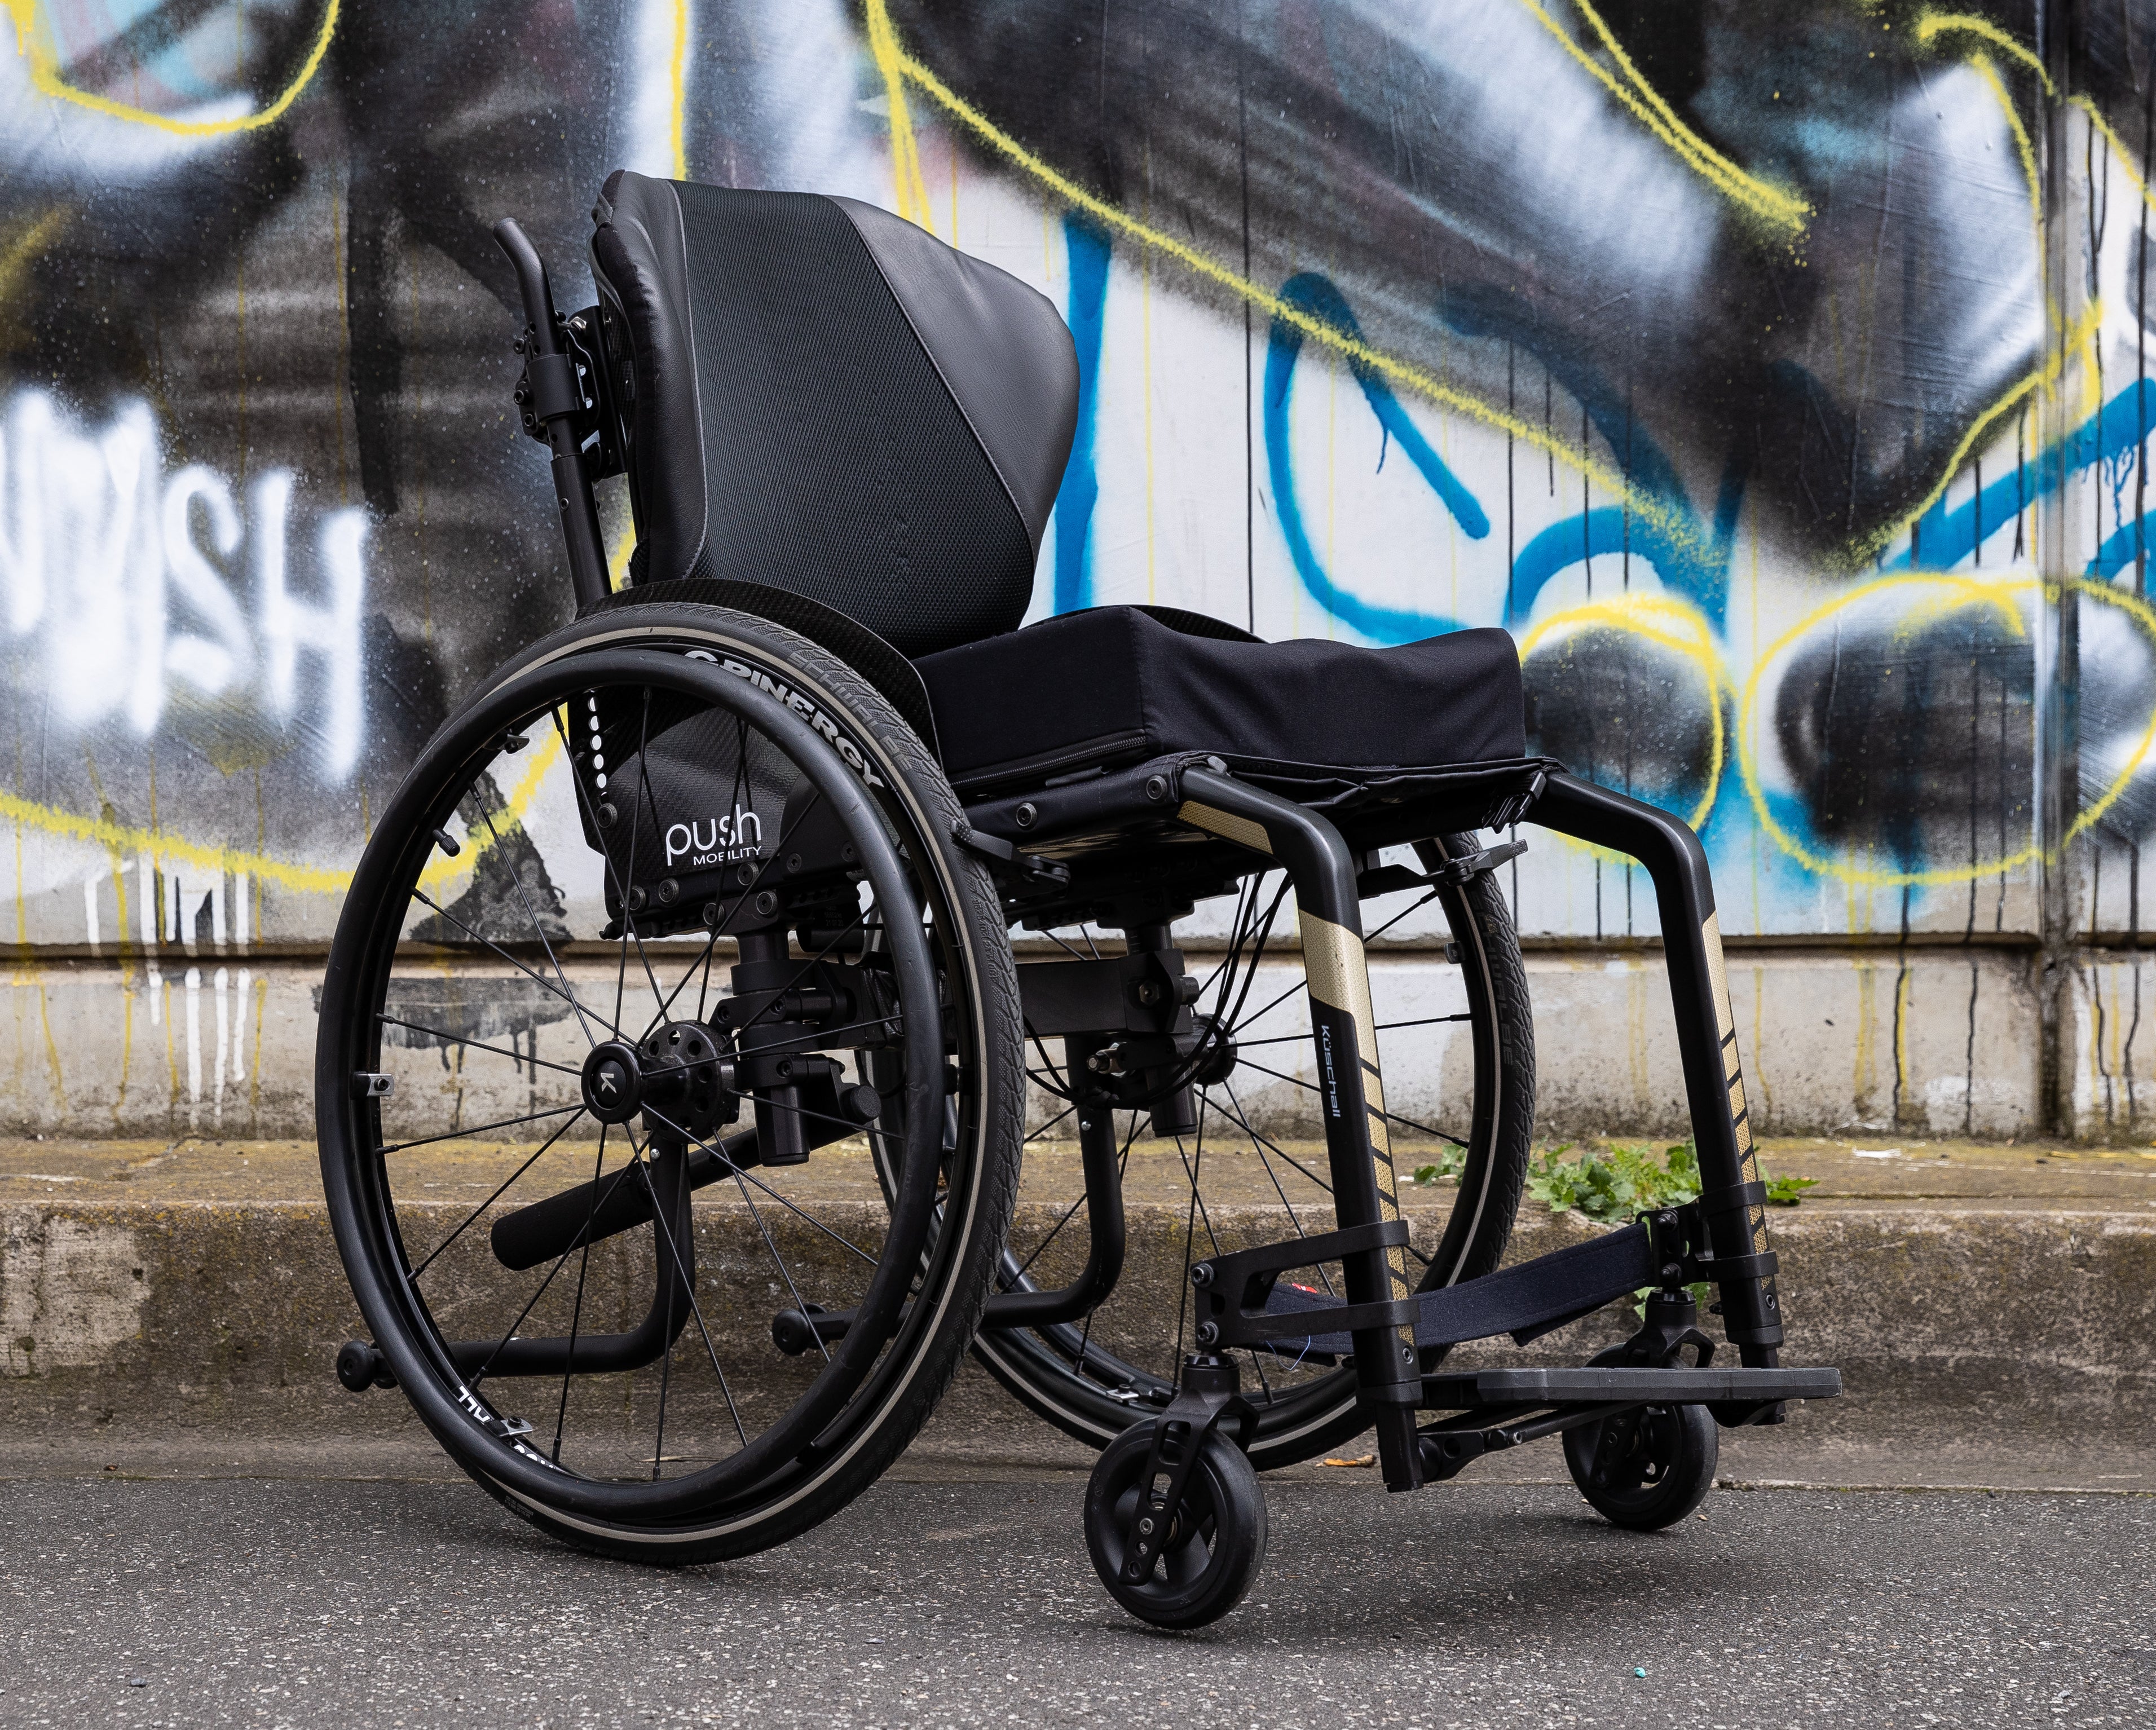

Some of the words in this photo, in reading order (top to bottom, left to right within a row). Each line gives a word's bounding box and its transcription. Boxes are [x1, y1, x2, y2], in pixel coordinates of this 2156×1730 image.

[787, 652, 912, 772] SCHWALBE
[665, 804, 762, 866] push
[693, 846, 762, 866] MOBILITY
